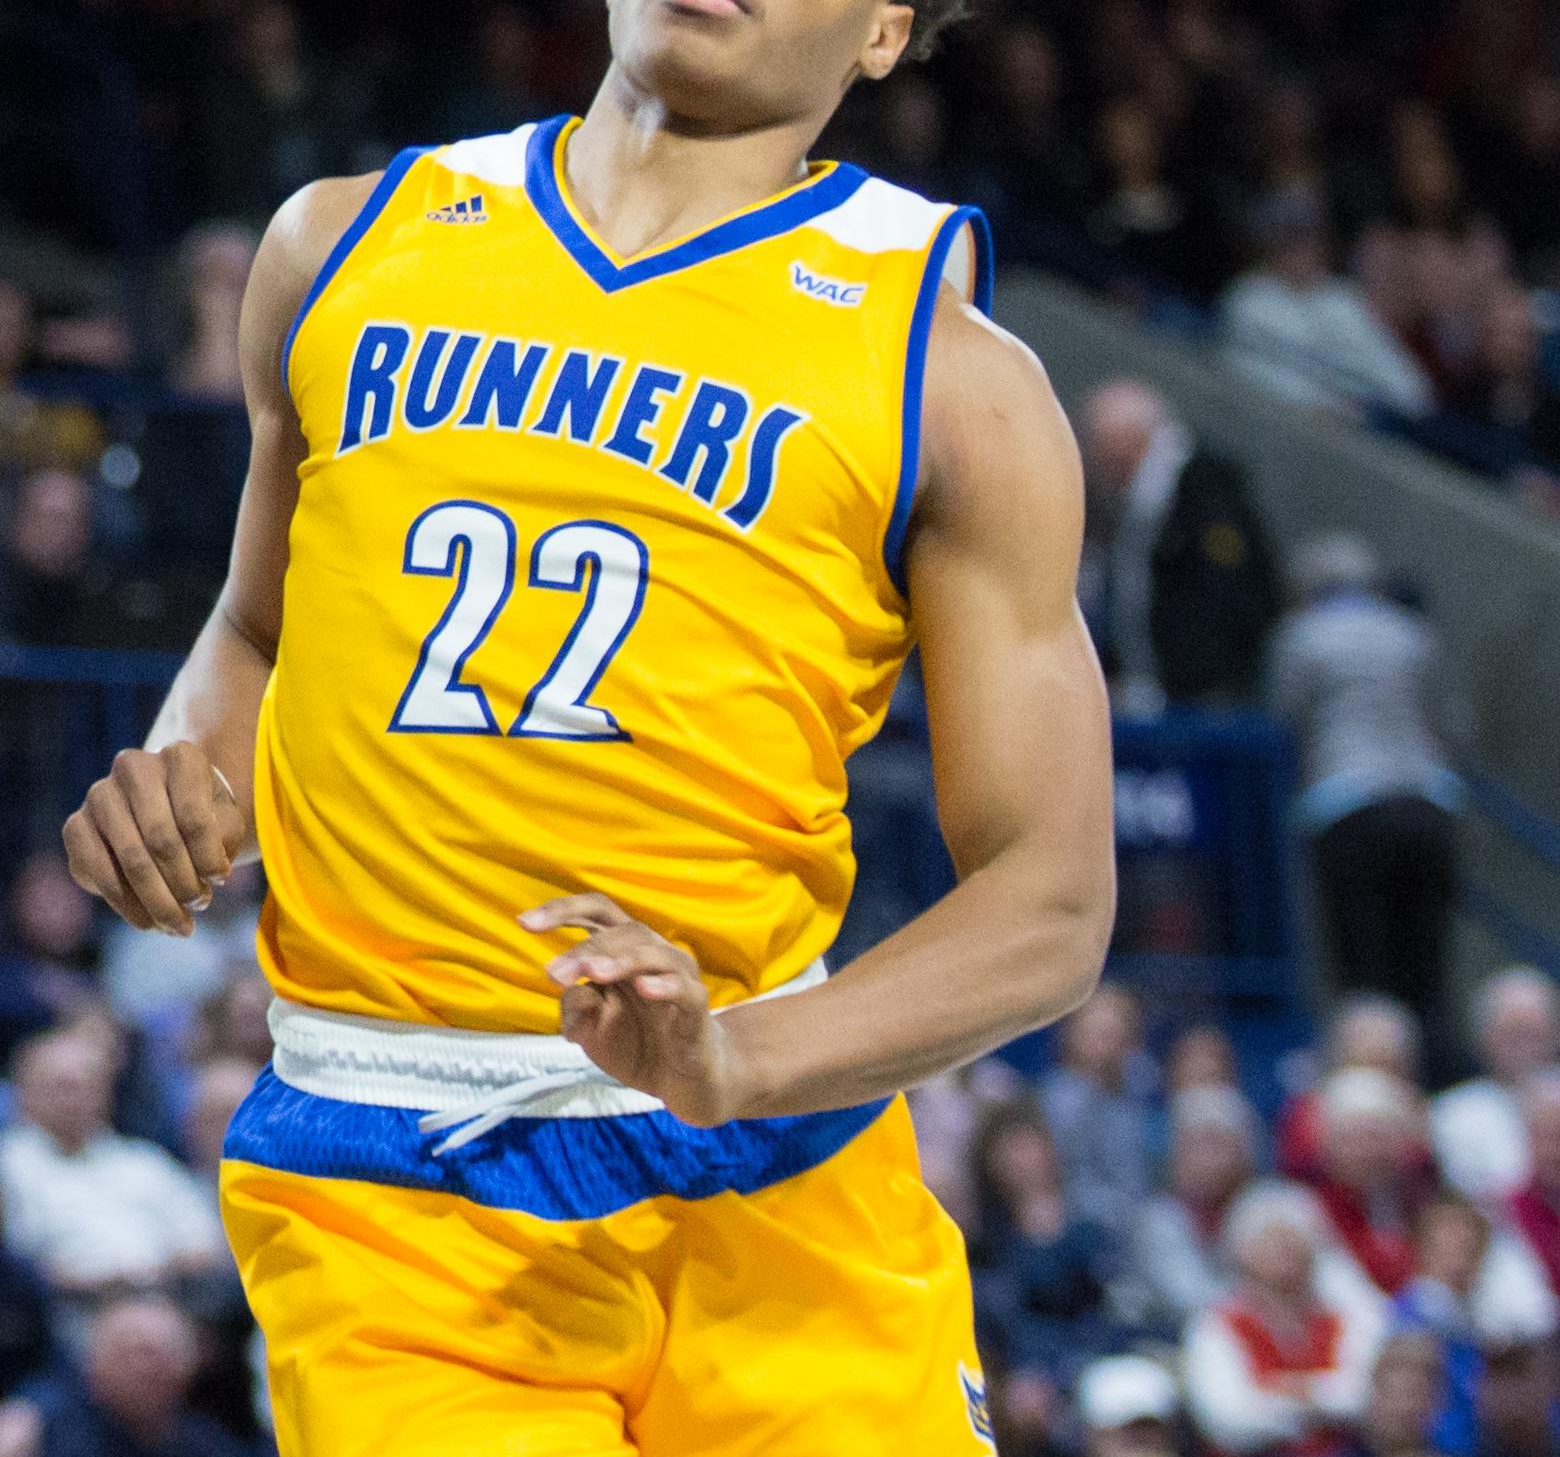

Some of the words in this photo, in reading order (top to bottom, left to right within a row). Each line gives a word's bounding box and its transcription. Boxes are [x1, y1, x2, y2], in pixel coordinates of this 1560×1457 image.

[793, 264, 865, 304] WAC
[336, 320, 810, 533] RUNNERS
[386, 499, 649, 743] 22
